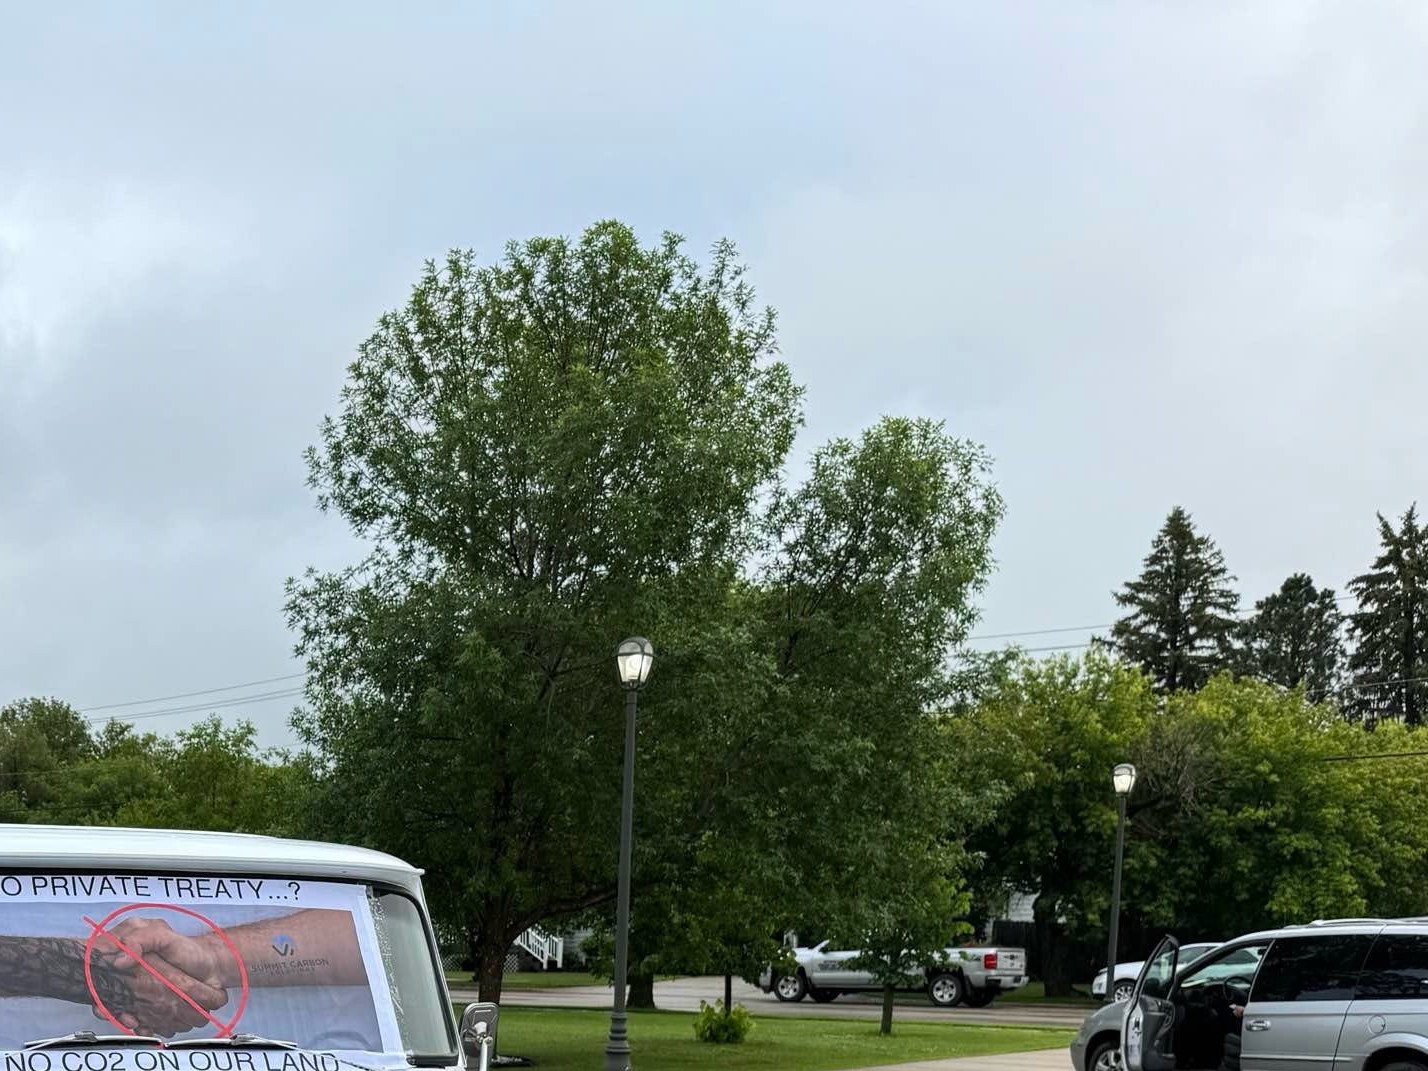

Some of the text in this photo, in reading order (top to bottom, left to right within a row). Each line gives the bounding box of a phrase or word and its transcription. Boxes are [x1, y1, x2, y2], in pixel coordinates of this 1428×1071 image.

[31, 876, 151, 897] PRIVATE
[158, 877, 301, 900] TREATY...?
[252, 961, 286, 973] SUMMIT
[290, 958, 330, 969] CARBON
[62, 1051, 126, 1071] CO2
[134, 1051, 180, 1071] ON
[189, 1051, 256, 1071] OUR
